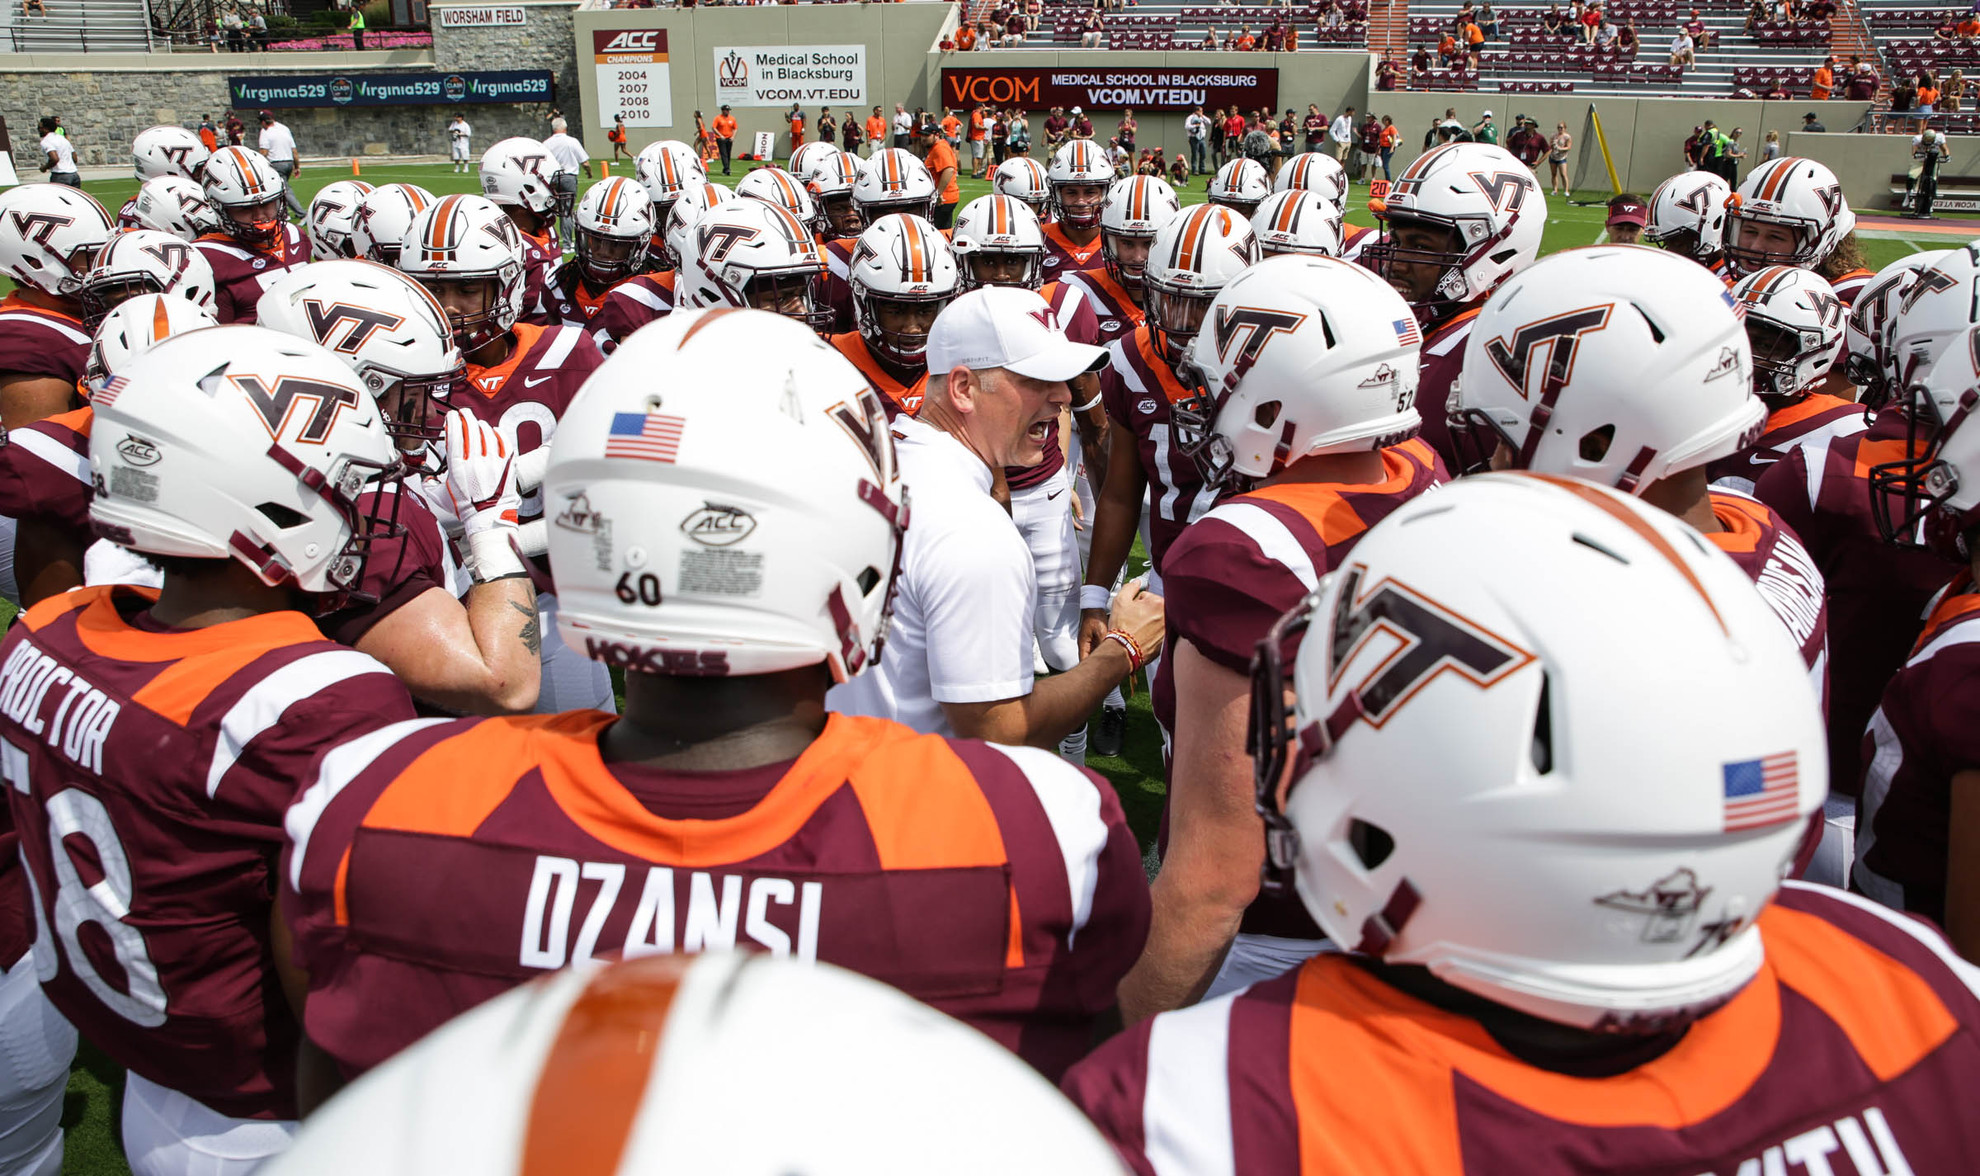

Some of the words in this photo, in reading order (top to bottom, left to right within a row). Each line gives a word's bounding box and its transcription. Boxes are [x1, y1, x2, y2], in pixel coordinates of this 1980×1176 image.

[444, 10, 493, 25] WORSHAM
[496, 9, 524, 23] FIELD
[607, 31, 659, 48] ACC
[607, 55, 653, 64] CHAMPIONS
[756, 54, 808, 66] Medical
[812, 53, 858, 65] School
[618, 71, 647, 80] 2004
[720, 78, 747, 87] VCOM
[762, 69, 773, 79] in
[778, 68, 853, 81] Blacksburg
[1051, 74, 1104, 86] MEDICAL
[1106, 75, 1157, 86] SCHOOL
[1158, 75, 1170, 86] IN
[1172, 75, 1257, 86] BLACKSBURG
[235, 83, 327, 102] Virginia529
[356, 81, 441, 99] Virginia529
[468, 78, 549, 97] Virginia529
[619, 84, 648, 93] 2007
[756, 89, 860, 99] VCOM.VT.EDU
[950, 76, 1040, 102] VCOM
[620, 97, 649, 106] 2008
[1088, 89, 1206, 105] VCOM.VT.EDU
[621, 110, 650, 119] 2010
[159, 146, 195, 165] VT
[510, 155, 547, 175] VT
[1371, 182, 1387, 196] 20
[1467, 171, 1534, 213] VT
[1675, 182, 1712, 214] VT
[1623, 205, 1638, 213] VT
[9, 210, 75, 242] VT
[698, 223, 762, 262] VT
[141, 243, 195, 271] VT
[1074, 252, 1091, 261] VT
[1172, 273, 1193, 281] ACC
[584, 304, 598, 315] VT
[1805, 289, 1842, 330] VT
[1849, 271, 1906, 339] VT
[303, 299, 406, 354] VT
[1215, 305, 1308, 368] VT
[1484, 303, 1615, 401] VT
[477, 376, 504, 391] VT
[1377, 372, 1390, 382] VT
[227, 374, 360, 446] VT
[900, 395, 923, 411] VT
[1138, 401, 1156, 410] ACC
[123, 444, 156, 458] ACC
[696, 511, 746, 530] ACC
[614, 571, 663, 607] 60
[1328, 562, 1540, 731] VT
[585, 636, 731, 677] HOKIES
[0, 638, 121, 776] PROCTOR
[520, 855, 823, 971] DZANSI
